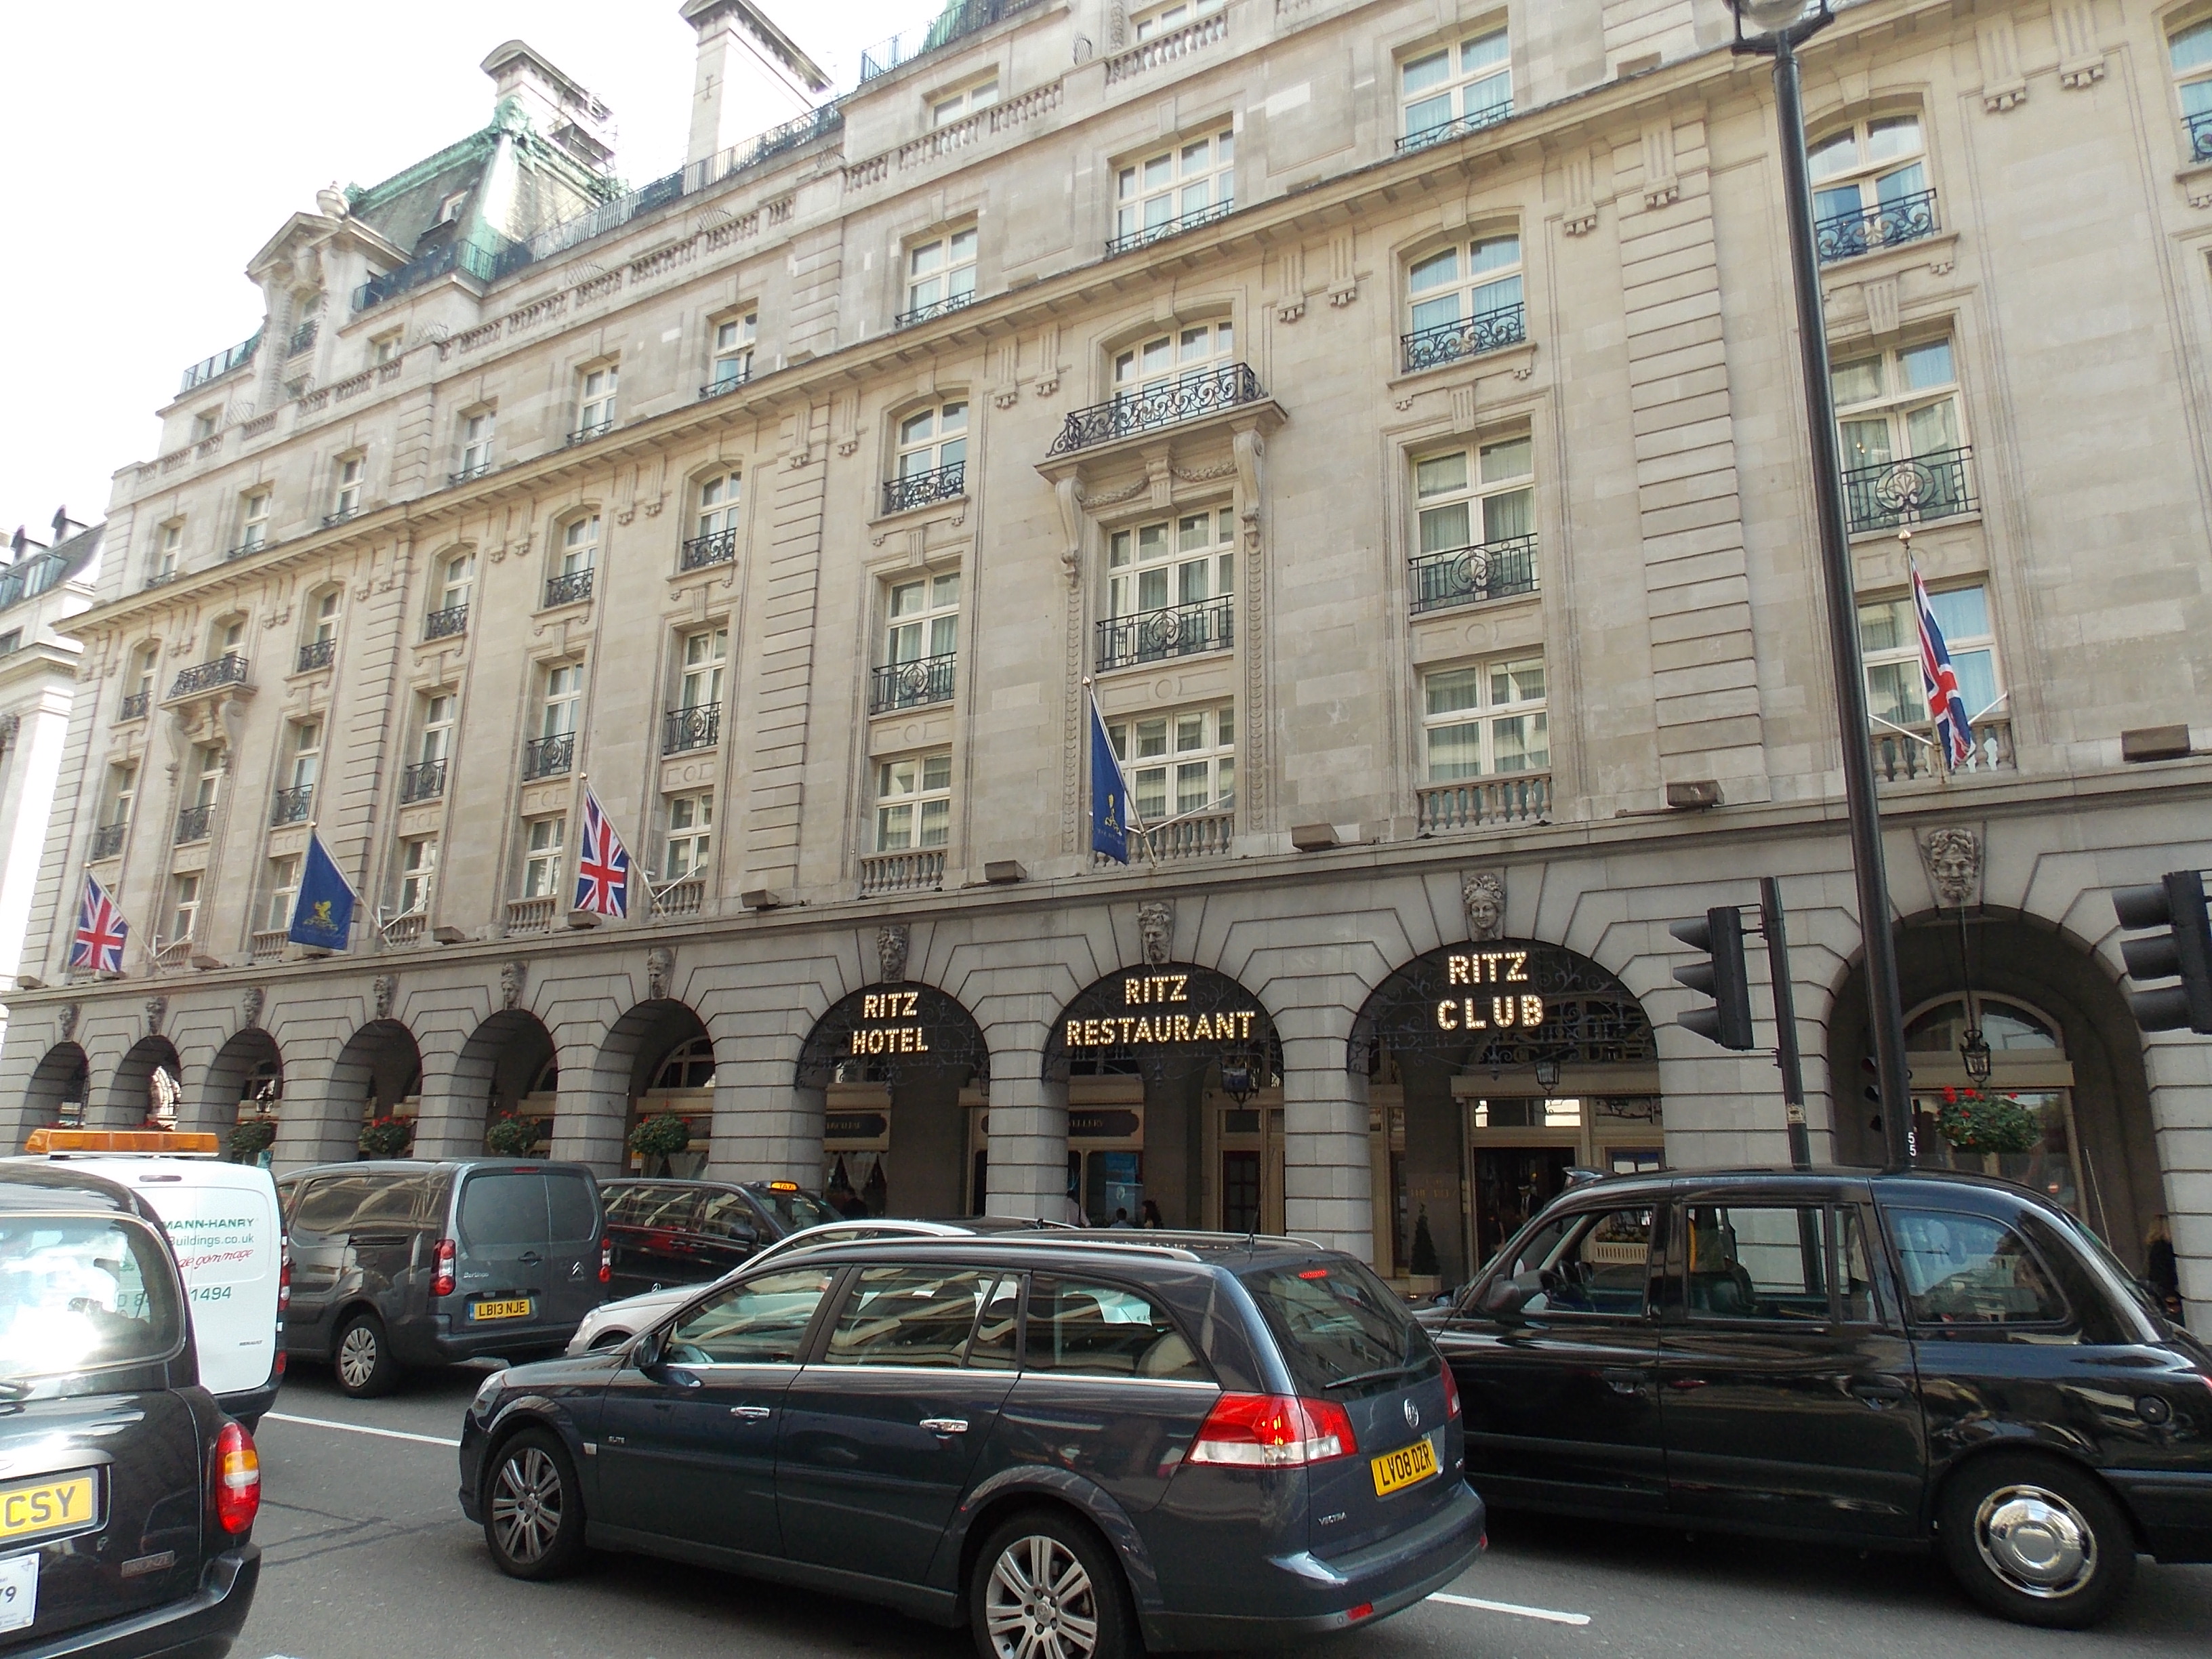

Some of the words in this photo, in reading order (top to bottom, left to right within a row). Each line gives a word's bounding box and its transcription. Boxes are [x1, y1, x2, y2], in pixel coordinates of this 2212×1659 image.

[1448, 951, 1528, 985] RITZ
[864, 991, 918, 1018] RITZ
[1125, 974, 1188, 1004] RITZ
[1066, 1010, 1256, 1046] RESTAURANT
[1437, 994, 1544, 1031] CLUB
[853, 1027, 928, 1054] HOTEL
[194, 1248, 254, 1270] gommage
[479, 1304, 504, 1317] LB13
[506, 1301, 525, 1314] NJE
[1379, 1452, 1412, 1487] LV08
[1411, 1443, 1432, 1474] DZR
[5, 1486, 77, 1528] CSY
